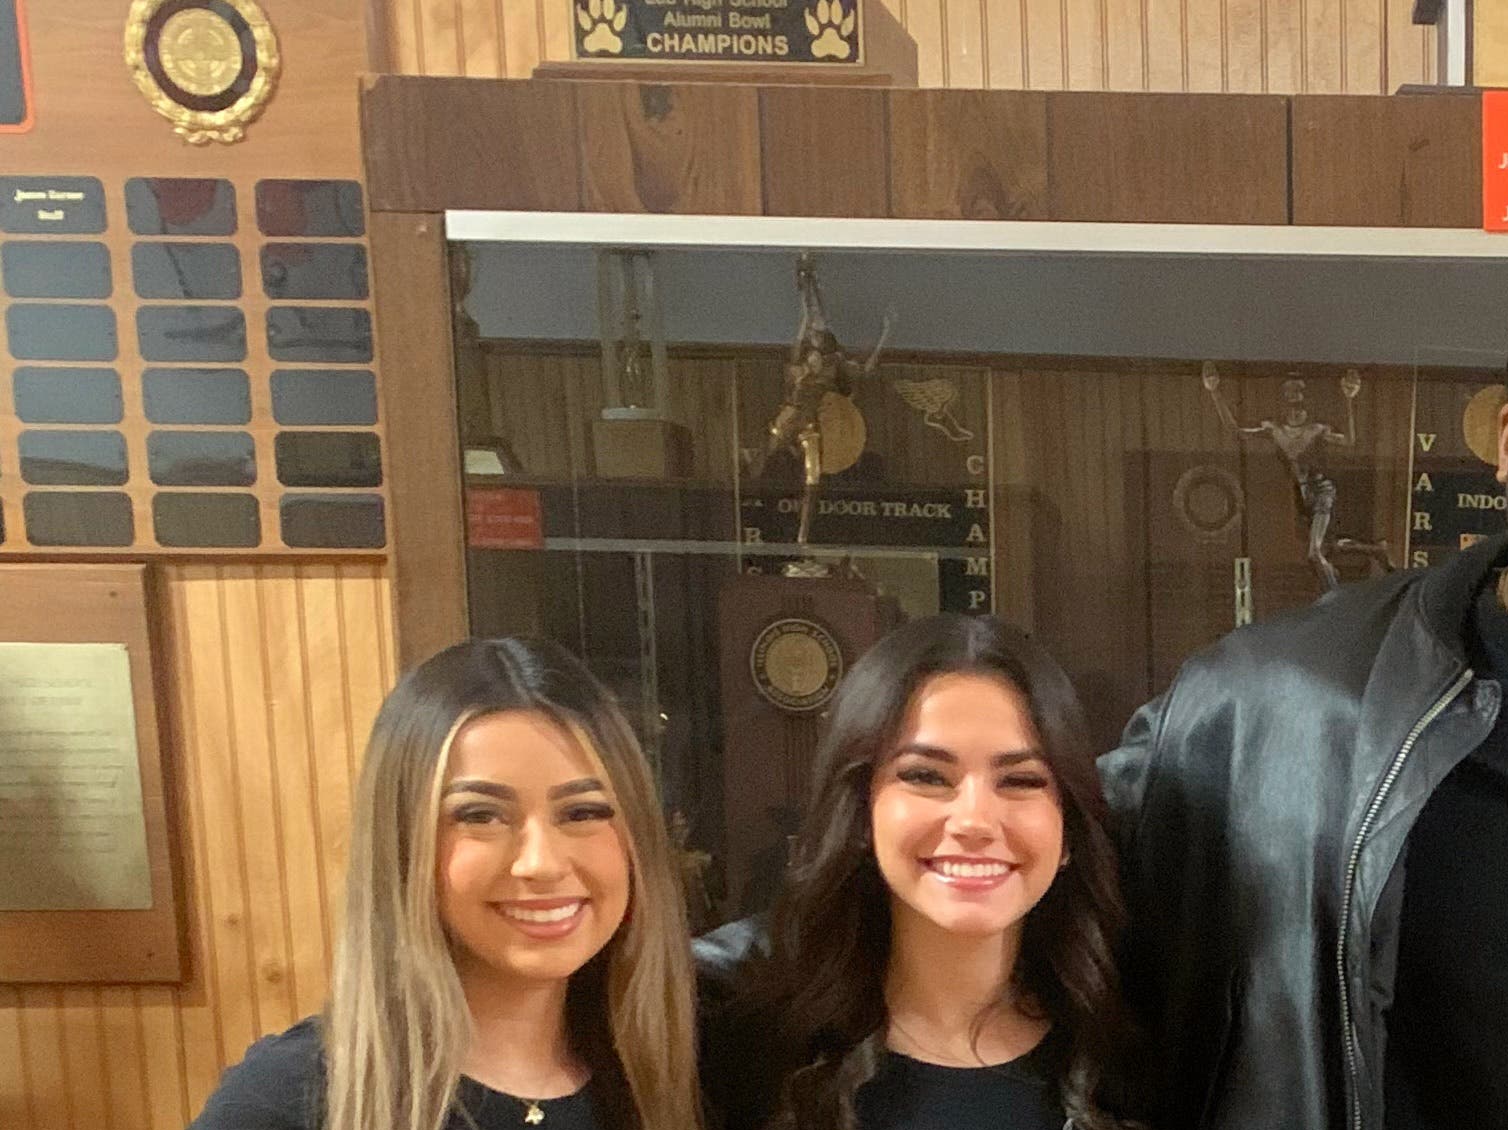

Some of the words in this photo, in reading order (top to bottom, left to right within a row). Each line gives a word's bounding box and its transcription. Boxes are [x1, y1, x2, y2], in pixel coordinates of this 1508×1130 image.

[664, 11, 722, 28] Alumni
[728, 11, 772, 29] Bowl
[646, 32, 790, 56] CHAMPIONS
[778, 499, 876, 516] ODOOR
[880, 502, 951, 519] TRACK
